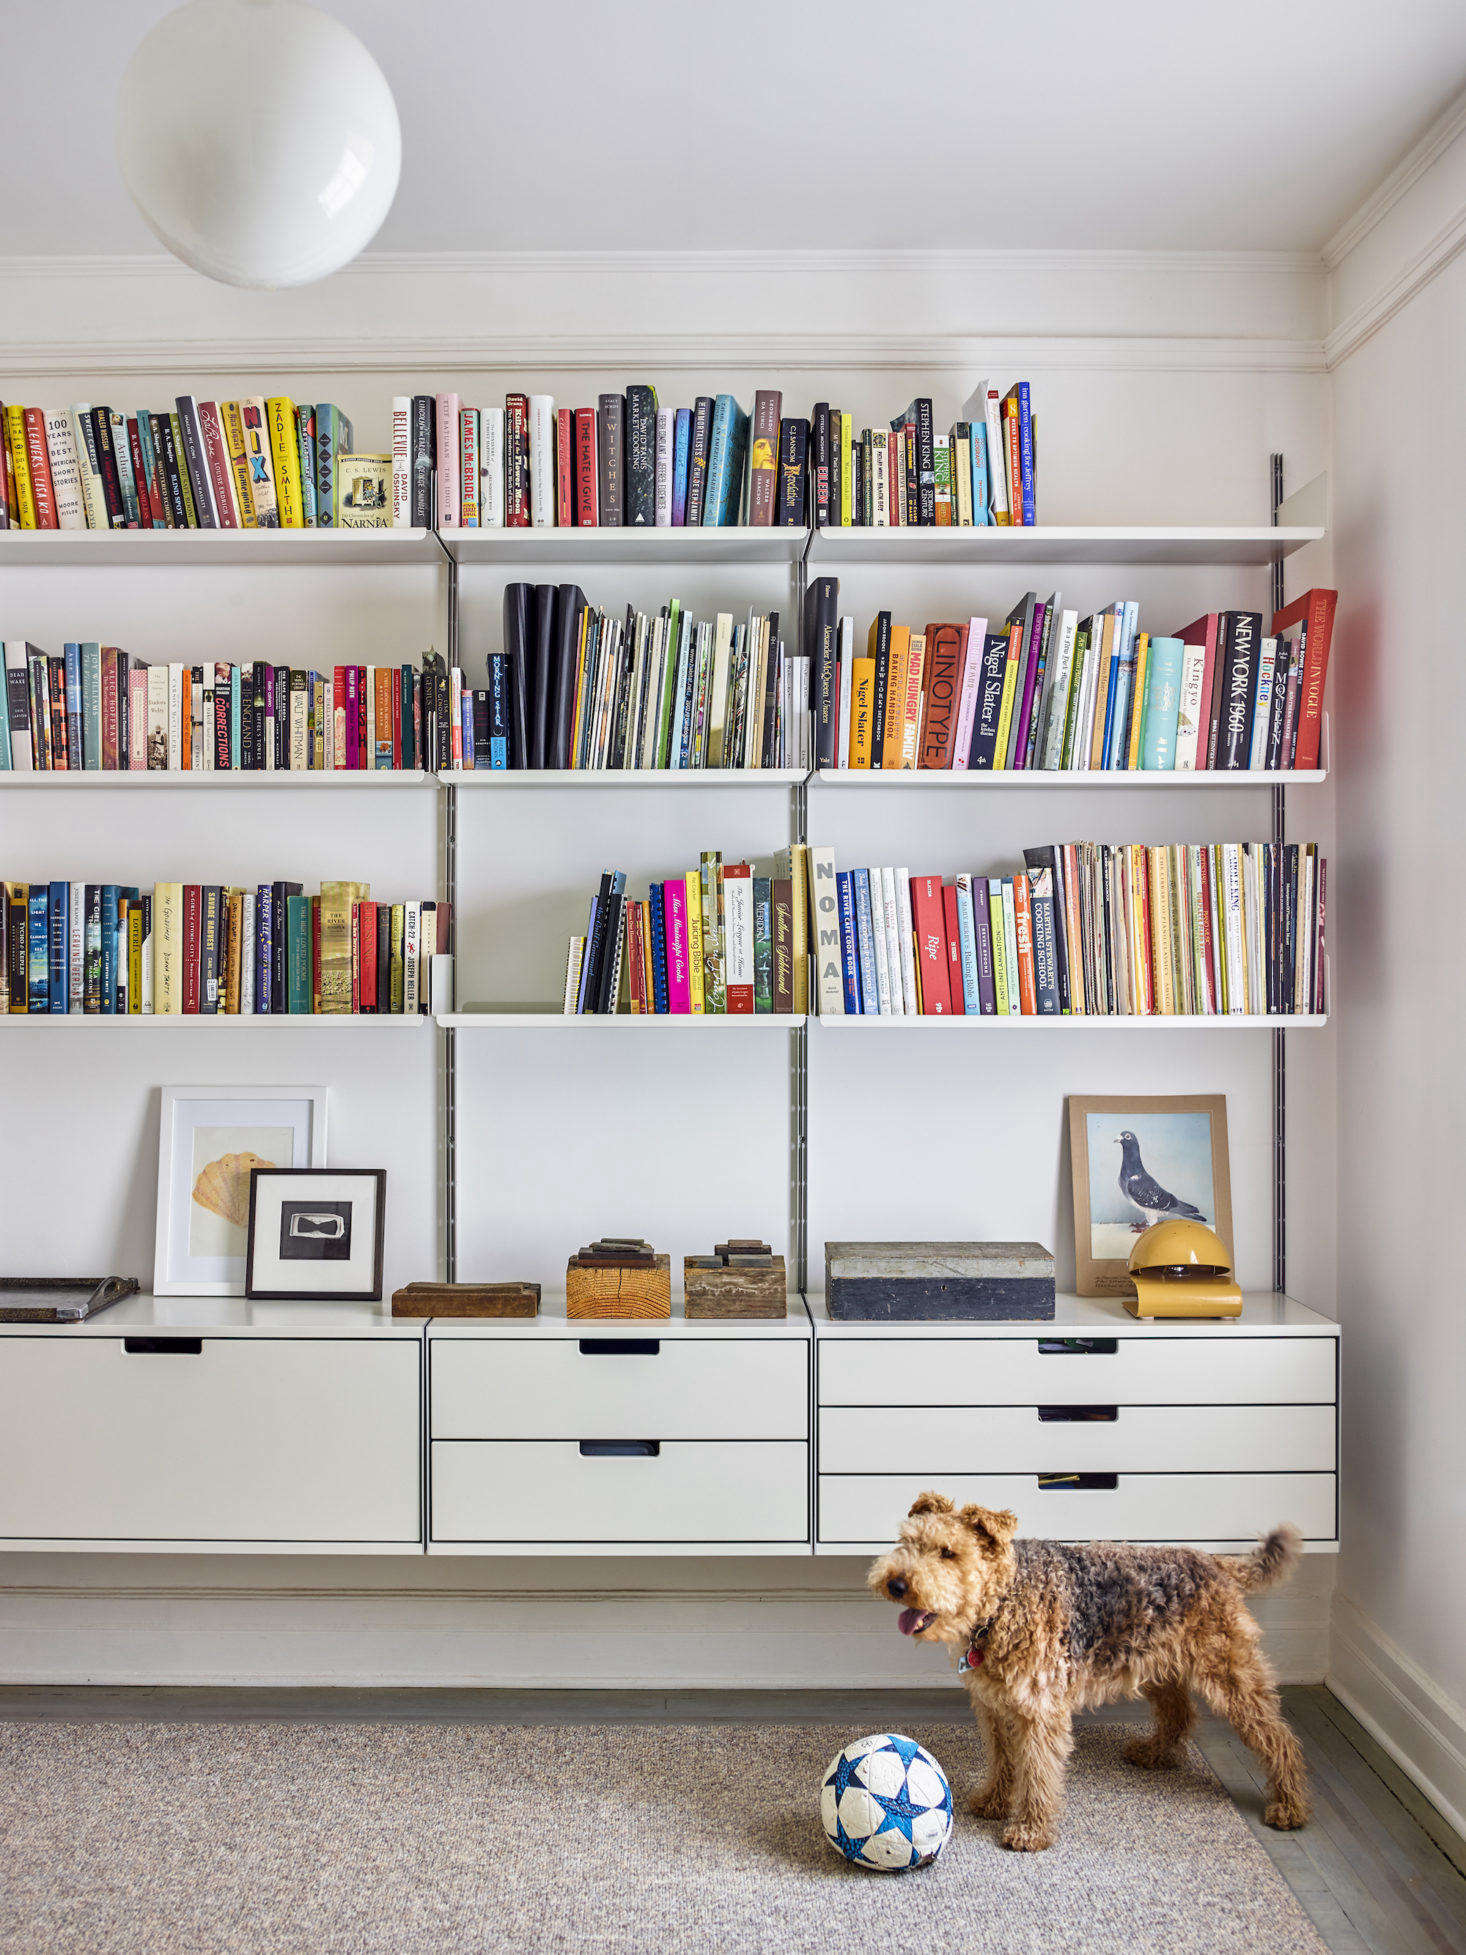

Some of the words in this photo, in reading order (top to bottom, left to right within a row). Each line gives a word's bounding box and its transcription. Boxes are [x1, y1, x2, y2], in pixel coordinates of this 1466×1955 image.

[48, 419, 68, 431] 100
[274, 403, 285, 453] ZADIE
[513, 408, 522, 440] Killers
[632, 394, 640, 428] MARKET
[920, 403, 930, 444] STEPHEN
[1021, 400, 1029, 423] garten
[27, 427, 44, 468] LEAVERS
[47, 431, 72, 440] YEARS
[84, 414, 92, 439] SWEET
[88, 439, 97, 466] CARESS
[393, 411, 408, 458] BELLEVUE
[463, 414, 474, 451] JAMES
[582, 423, 591, 442] THE
[694, 407, 706, 456] IMMORTALISTS
[50, 459, 76, 467] AMERICAN
[51, 447, 72, 457] BEST
[582, 445, 591, 473] HATE
[607, 423, 618, 503] WITCHES
[632, 430, 640, 471] COOKING
[712, 436, 720, 471] AMERICAN
[921, 444, 931, 469] KING
[935, 450, 944, 483] KING
[53, 468, 76, 477] SHORT
[53, 477, 79, 487] STORIES
[171, 474, 179, 495] BLIND
[464, 452, 475, 500] McBRIDE
[514, 455, 522, 487] Flower
[817, 466, 829, 504] EILEEN
[1023, 467, 1031, 492] Jeffrey
[34, 478, 46, 499] LISA
[81, 460, 92, 500] WILLIAM
[87, 503, 96, 529] BOYD
[237, 468, 253, 515] Homegoing
[281, 465, 293, 516] SMITH
[514, 488, 522, 515] Moon
[583, 485, 592, 512] GIVE
[690, 488, 700, 521] BENJAMIN
[38, 501, 49, 514] KO
[174, 496, 183, 516] SPOT
[1313, 599, 1327, 623] THE
[822, 624, 831, 660] Alexander
[1233, 615, 1253, 654] NEW
[1311, 624, 1325, 667] WORLD
[889, 653, 899, 687] BAKING
[910, 652, 922, 675] MAD
[985, 640, 1006, 677] Nigel
[1310, 665, 1322, 679] IN
[819, 660, 832, 698] McQueen
[857, 678, 870, 708] Nigel
[1188, 657, 1204, 706] Kingyo
[1230, 654, 1251, 699] YORK
[1257, 656, 1275, 708] Hockney
[294, 693, 304, 716] WALT
[821, 699, 831, 724] Unseen
[886, 690, 897, 740] HANDBOOK
[905, 677, 920, 722] HUNGRY
[926, 640, 957, 759] LINOTYPE
[981, 680, 1001, 724] Slater
[1227, 700, 1246, 733] 1960
[1305, 681, 1321, 720] VOGUE
[215, 697, 230, 768] CORRECTIONS
[242, 698, 252, 749] ENGLAND
[294, 717, 304, 760] WHITMAN
[857, 711, 867, 747] Slater
[902, 722, 916, 760] FAMILY
[207, 892, 215, 918] SAVAGE
[1230, 888, 1241, 912] KING
[206, 920, 215, 951] HARVEST
[407, 911, 416, 939] CATCH-22
[690, 917, 701, 951] Juicing
[756, 901, 766, 945] MERIDIAN
[775, 902, 792, 943] Southern
[816, 862, 840, 979] NOMA
[861, 915, 869, 950] PROPER
[1016, 911, 1032, 955] fresh
[1034, 902, 1044, 949] COOKING
[1042, 902, 1052, 940] MARTHA
[71, 928, 81, 963] LEAVING
[163, 952, 171, 972] DONNA
[692, 950, 701, 974] Bible
[863, 951, 871, 969] PUB
[924, 934, 940, 961] Ripe
[72, 967, 81, 996] BERLIN
[407, 956, 416, 979] JOSEPH
[675, 959, 684, 984] Cooks
[775, 944, 791, 995] Sideboards
[846, 956, 854, 976] BOOK
[964, 951, 973, 978] Baking
[995, 930, 1006, 1001] ANTI-INFLAMMATION
[1037, 950, 1046, 991] SCHOOL
[1044, 941, 1055, 991] STEWART'S
[407, 980, 416, 1001] HELLER
[966, 979, 976, 999] Bible
